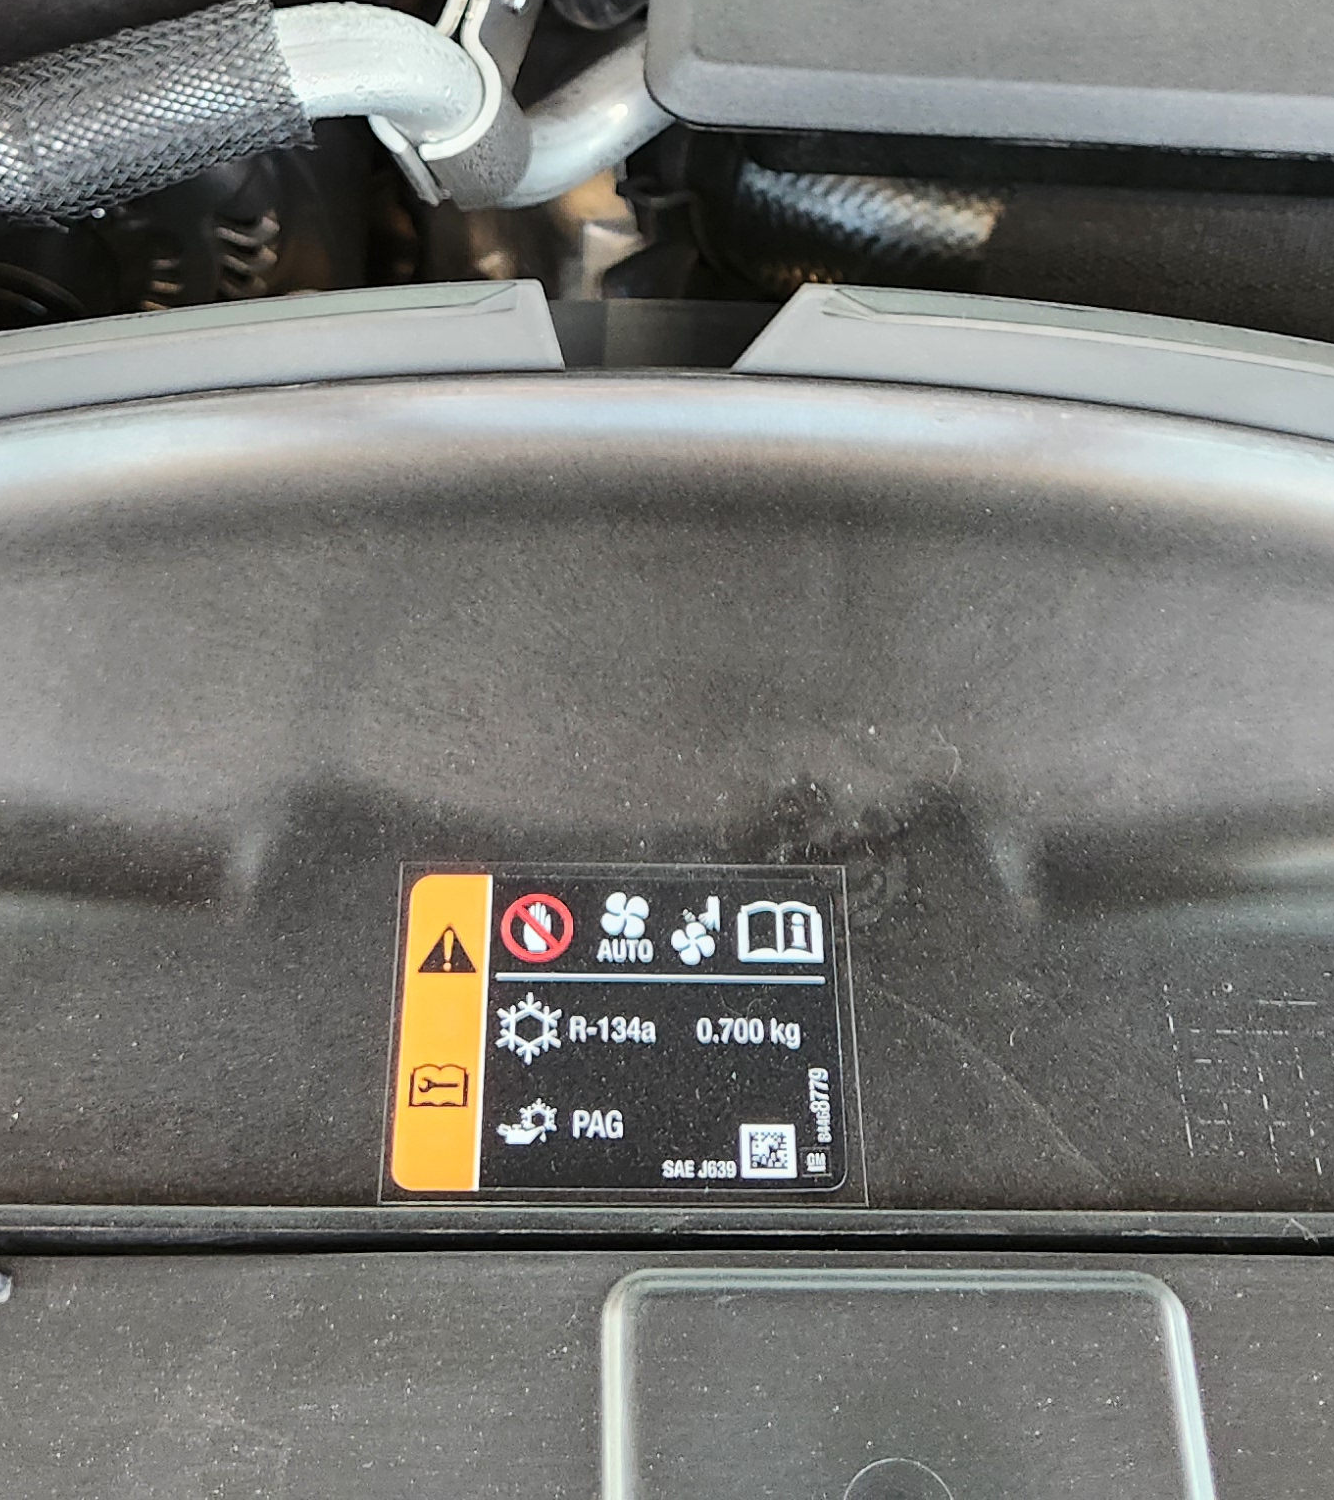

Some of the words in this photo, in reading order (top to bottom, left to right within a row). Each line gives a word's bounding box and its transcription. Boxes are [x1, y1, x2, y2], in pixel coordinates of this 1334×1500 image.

[597, 938, 654, 963] AUTO
[569, 1015, 657, 1044] R-134a
[696, 1017, 765, 1045] 0.700
[769, 1017, 801, 1050] kg
[572, 1109, 624, 1139] PAG
[662, 1159, 695, 1179] SAE
[697, 1159, 737, 1179] J639
